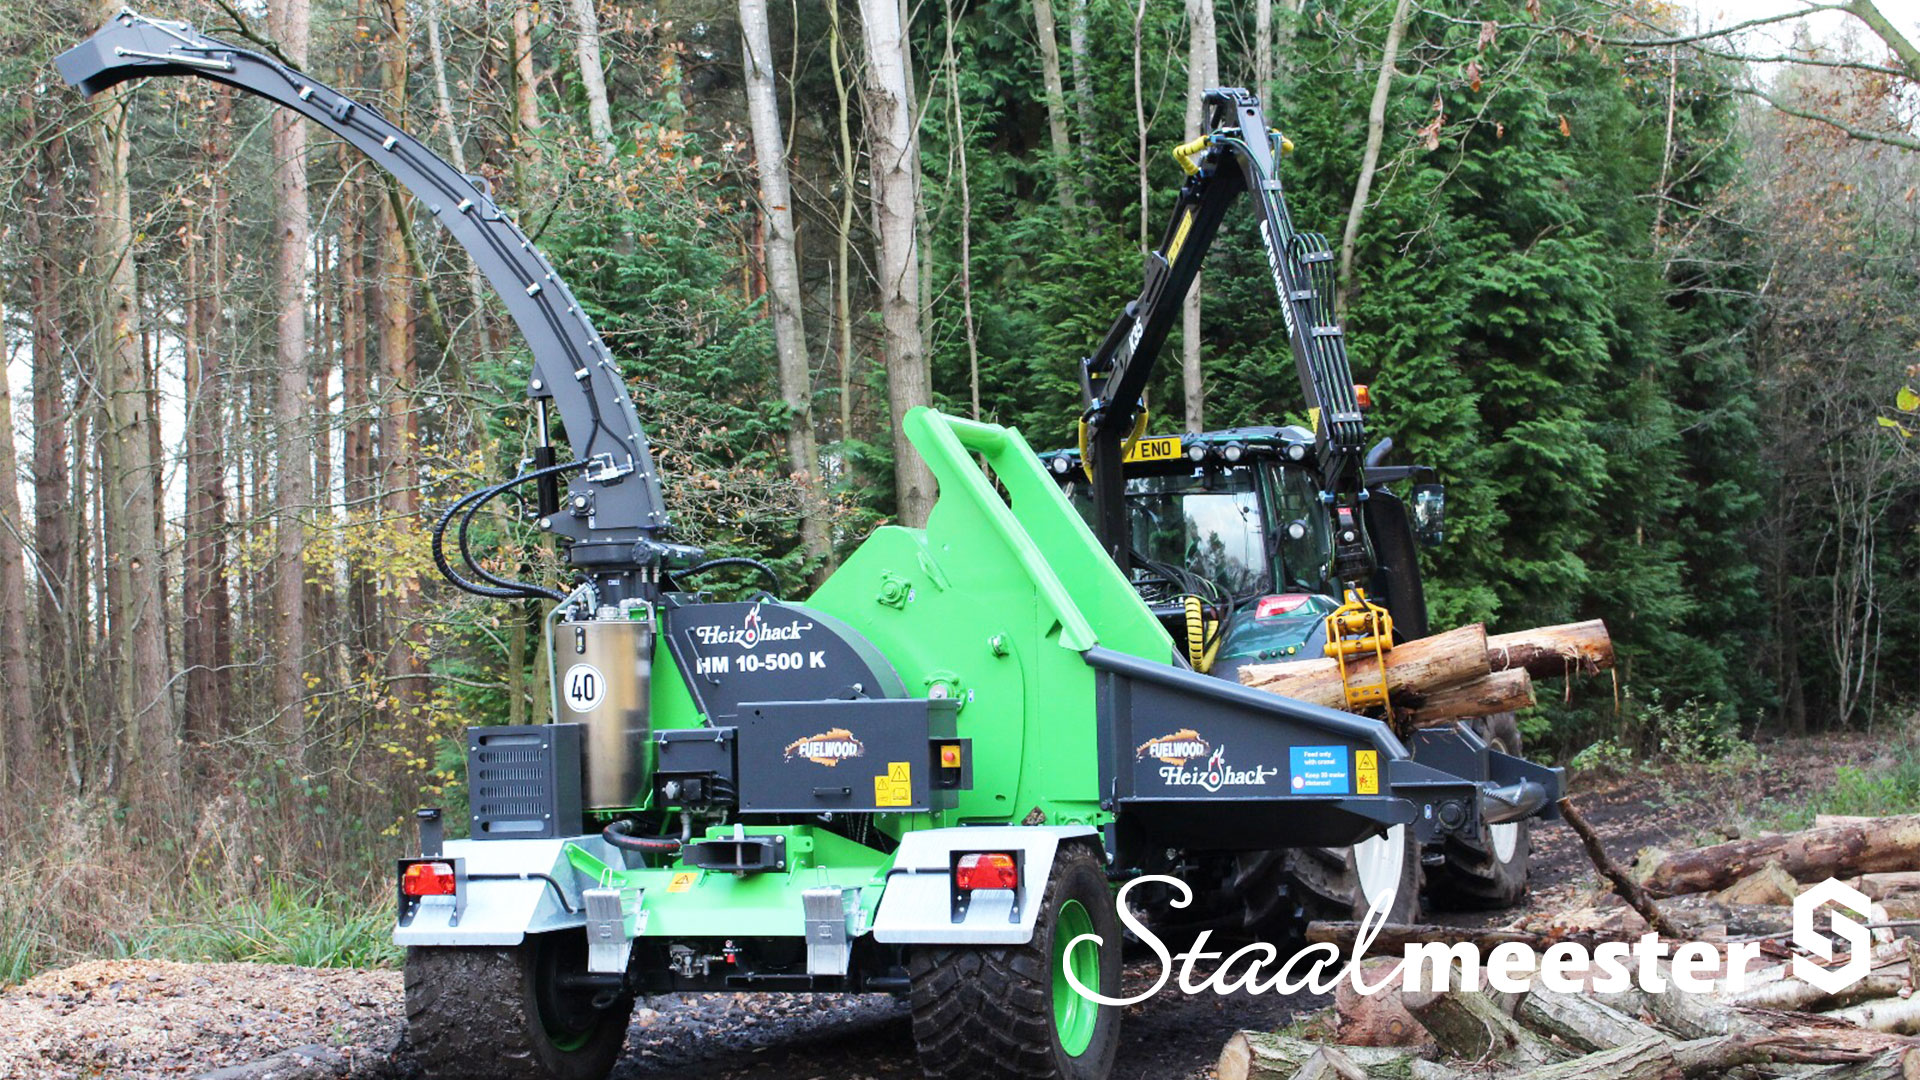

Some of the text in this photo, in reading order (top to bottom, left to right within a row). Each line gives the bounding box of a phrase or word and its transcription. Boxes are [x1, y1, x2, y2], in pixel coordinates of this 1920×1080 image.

[1141, 441, 1171, 458] ENO
[696, 650, 826, 674] HM 10-500 K
[571, 673, 595, 702] 40
[799, 741, 858, 758] FUELWOOD
[1149, 742, 1204, 759] FUELWOOD
